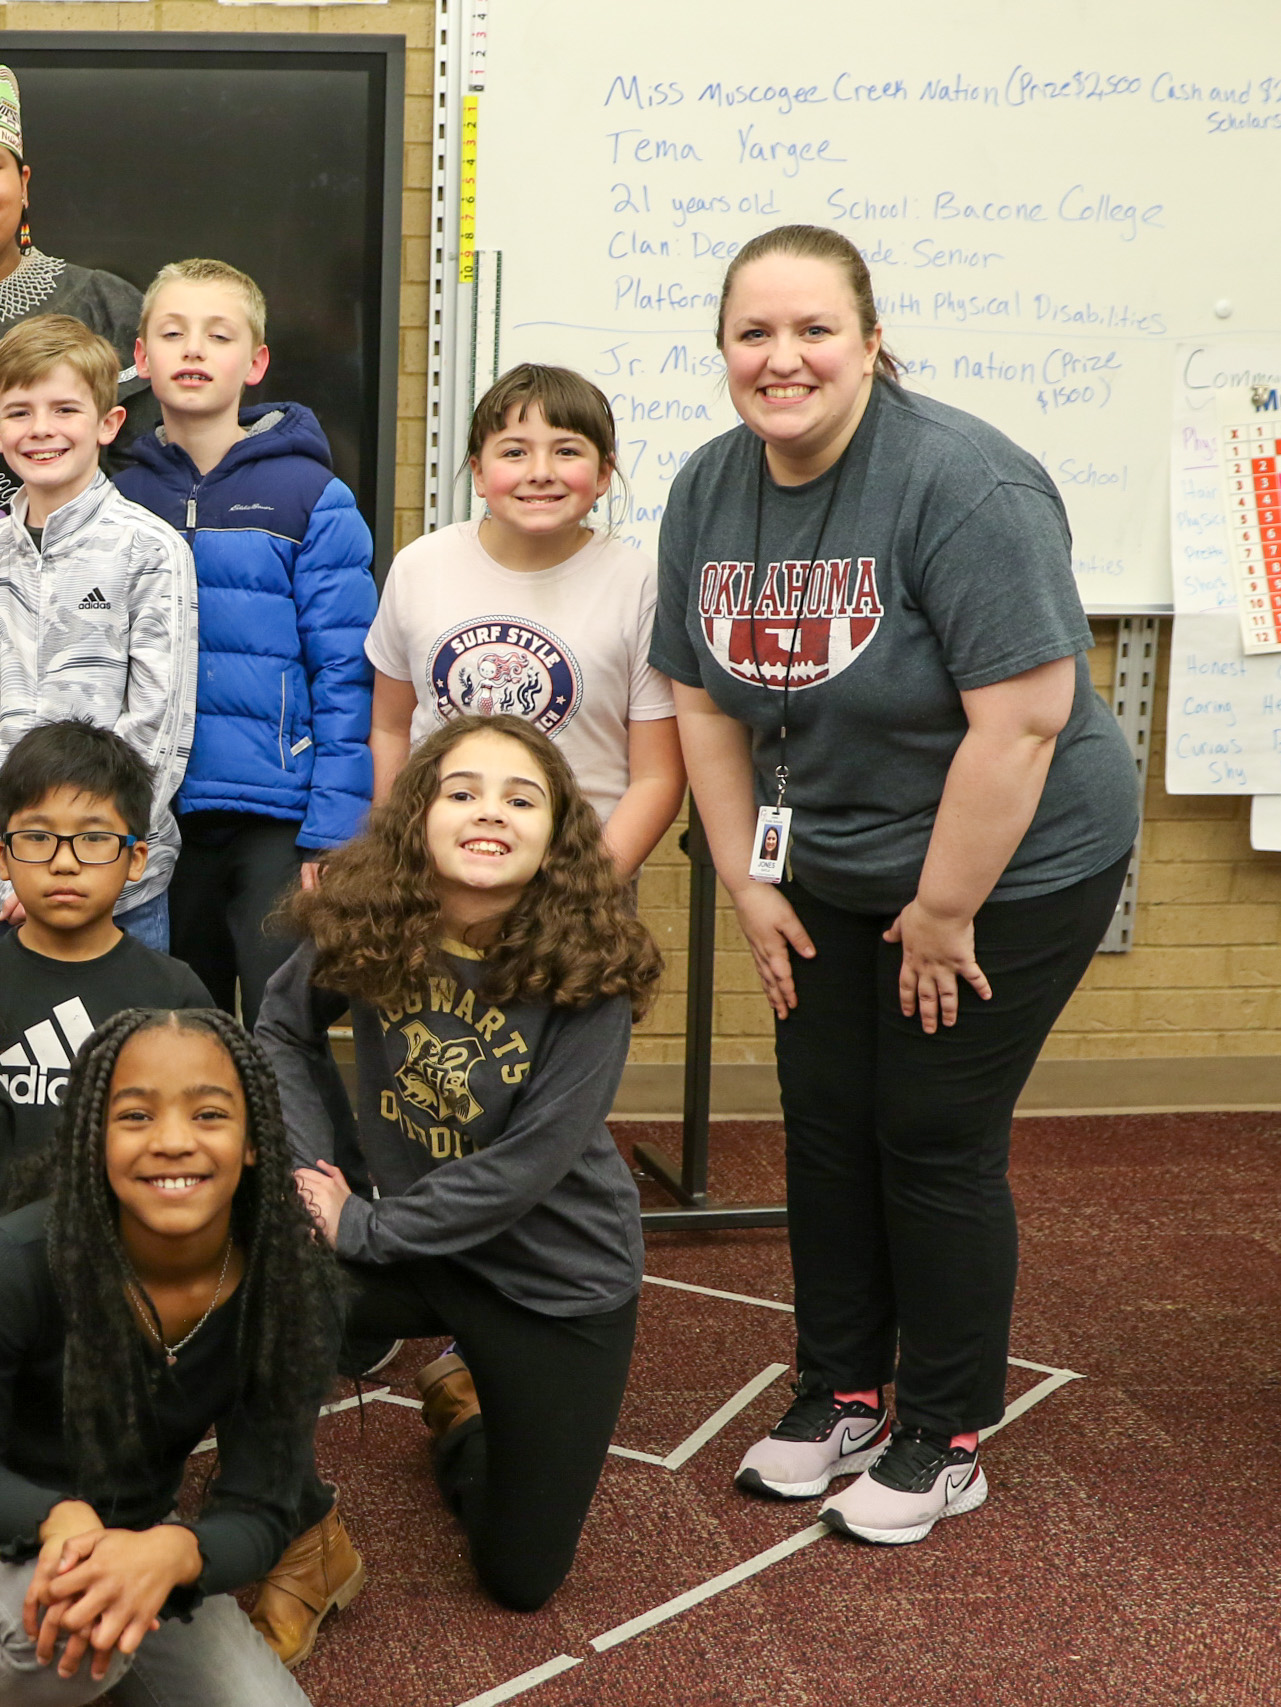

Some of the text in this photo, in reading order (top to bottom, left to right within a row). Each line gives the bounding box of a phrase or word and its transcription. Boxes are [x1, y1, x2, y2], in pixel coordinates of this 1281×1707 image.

[604, 75, 684, 109] Miss
[698, 82, 828, 115] Muscogee
[833, 72, 907, 102] Creek
[920, 73, 999, 106] Nation
[1151, 72, 1203, 102] Cash
[1209, 80, 1252, 104] and
[606, 124, 847, 177] Tema Yargee
[611, 183, 650, 213] 21
[672, 195, 730, 227] years
[738, 190, 780, 214] old
[933, 191, 1048, 222] Bacone
[1058, 184, 1166, 241] College
[691, 232, 740, 259] Dee
[913, 239, 1005, 268] Senior
[594, 342, 645, 376] Jr.
[660, 345, 726, 377] Miss
[1058, 458, 1128, 492] School
[1234, 460, 1268, 473] 2 2
[1262, 494, 1272, 505] 4
[1241, 511, 1274, 525] 5 5
[1266, 528, 1276, 539] 6
[1244, 545, 1278, 558] 7 7
[698, 557, 884, 620] OKLAHOMA
[78, 601, 111, 610] adidas
[1250, 598, 1264, 609] 10
[450, 626, 562, 669] SURF STYLE
[1255, 632, 1270, 643] 12
[1187, 655, 1248, 677] Honest
[1183, 696, 1236, 727] Caring
[1176, 733, 1243, 759] Curious
[1208, 761, 1248, 786] Shy
